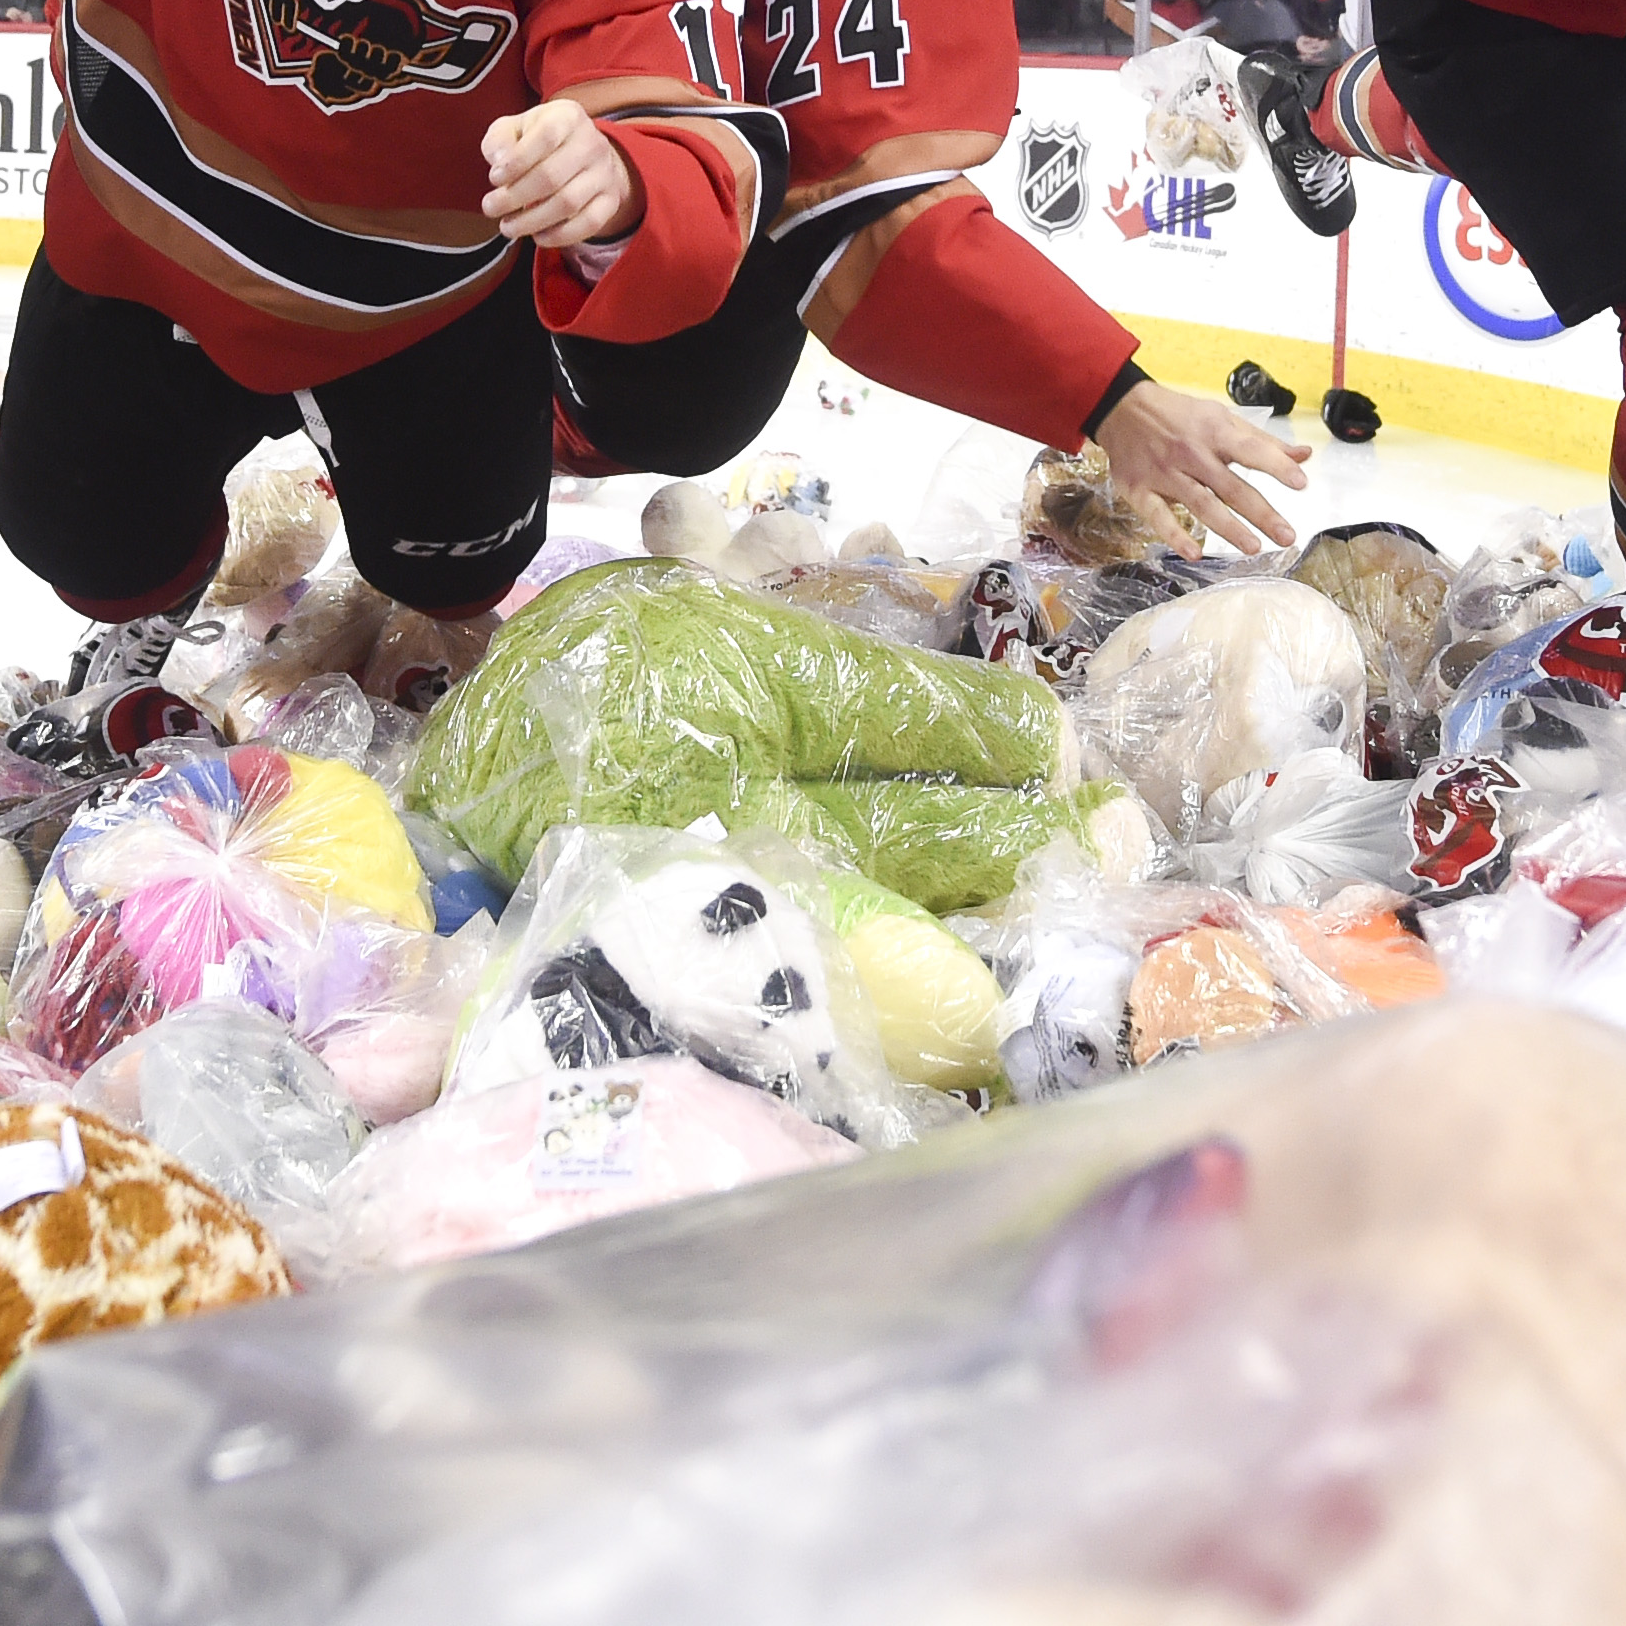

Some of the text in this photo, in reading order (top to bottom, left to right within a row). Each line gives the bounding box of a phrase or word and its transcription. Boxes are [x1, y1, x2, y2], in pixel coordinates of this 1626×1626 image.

[1031, 153, 1076, 212] NHL
[1142, 174, 1212, 240] CHL
[392, 494, 540, 557] CCM
